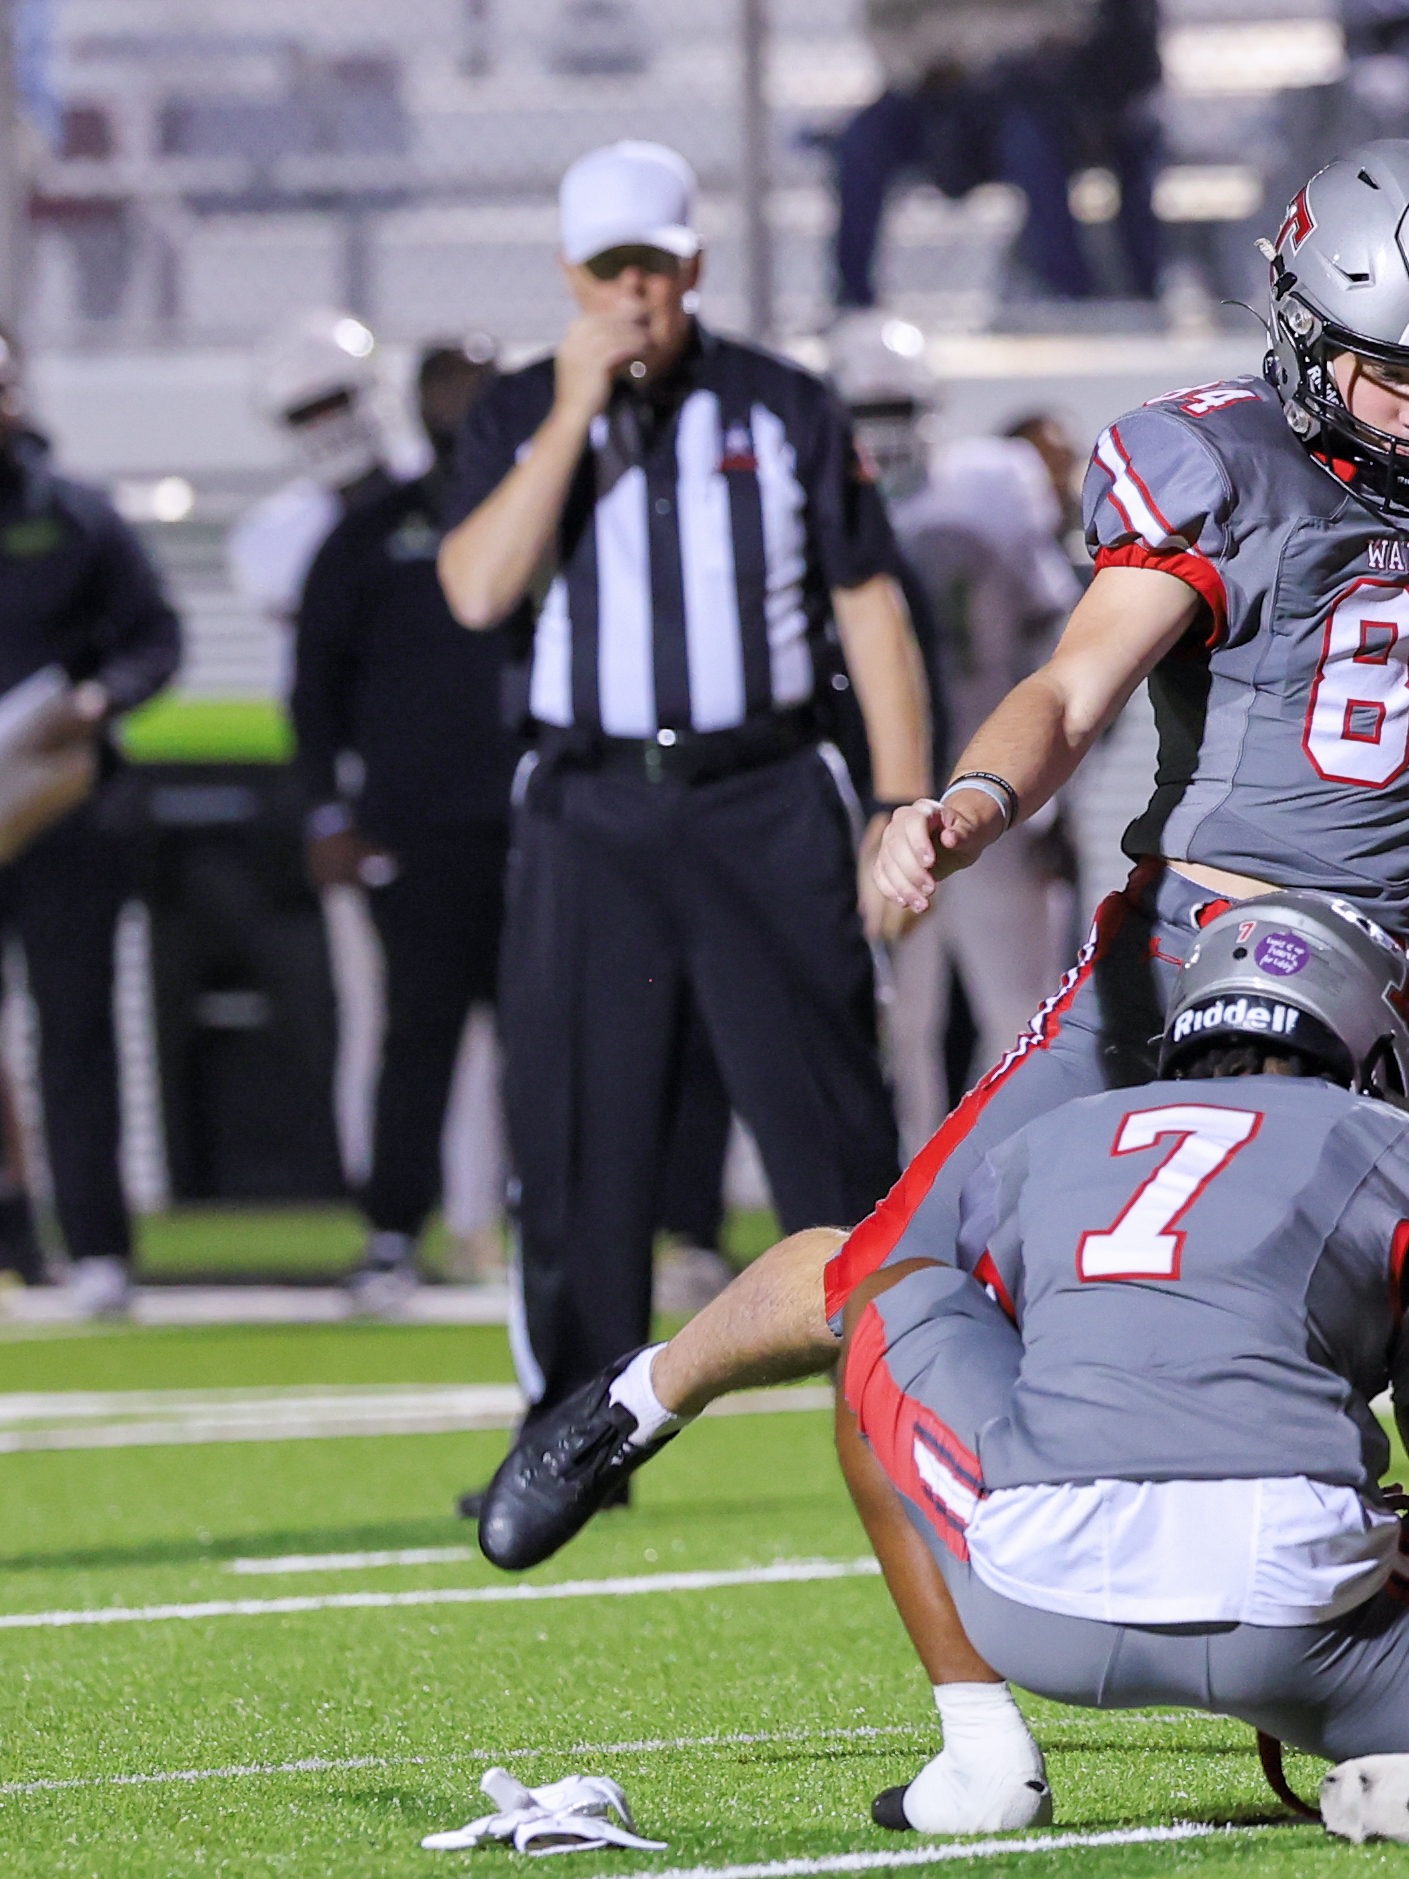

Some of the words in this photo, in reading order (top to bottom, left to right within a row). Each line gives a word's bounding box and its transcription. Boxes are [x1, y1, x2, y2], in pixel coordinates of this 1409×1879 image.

[1236, 921, 1257, 943] 7
[1173, 998, 1299, 1042] Riddell
[1076, 1103, 1266, 1283] 7
